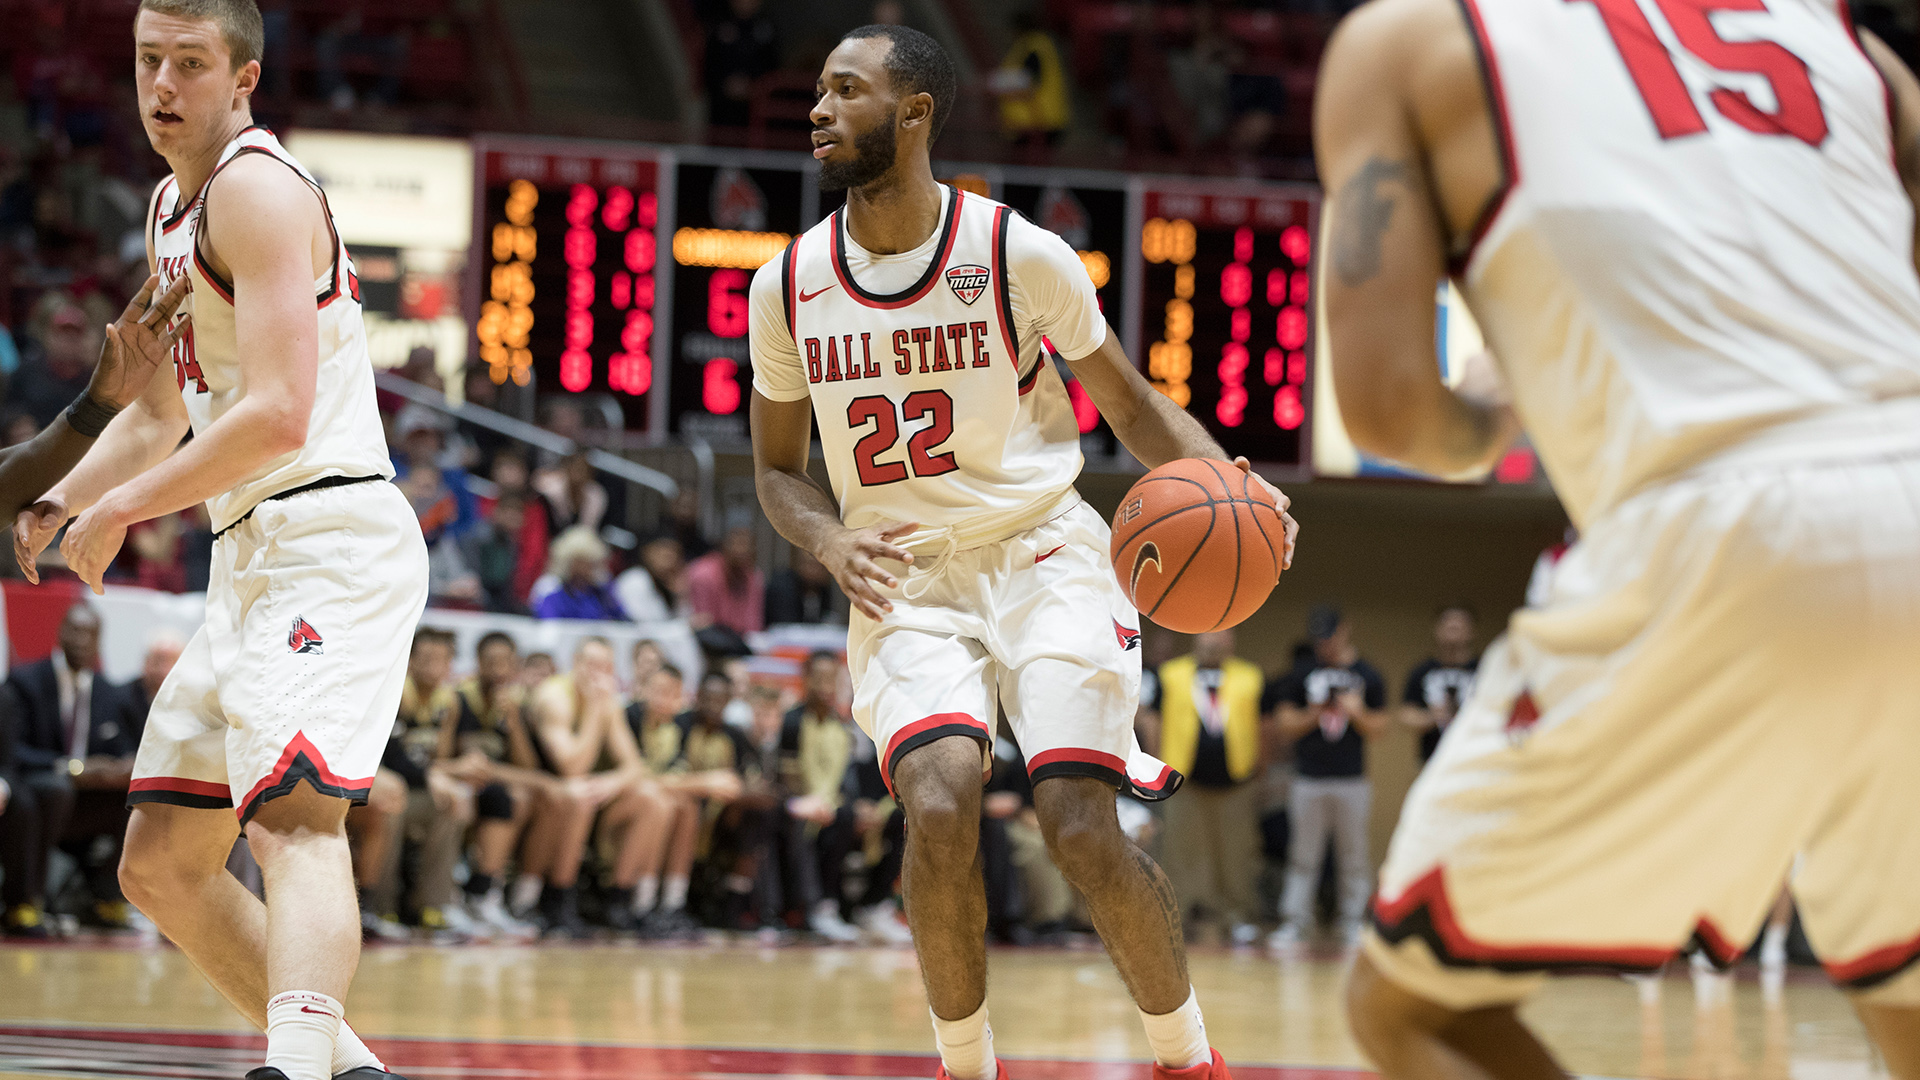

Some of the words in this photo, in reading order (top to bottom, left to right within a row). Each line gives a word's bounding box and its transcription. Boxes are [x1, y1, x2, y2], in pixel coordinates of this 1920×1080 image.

[1563, 0, 1829, 148] 15
[707, 268, 749, 338] 6
[950, 276, 987, 288] MAC
[805, 332, 881, 384] BALL
[892, 321, 990, 375] STATE
[846, 389, 960, 487] 22
